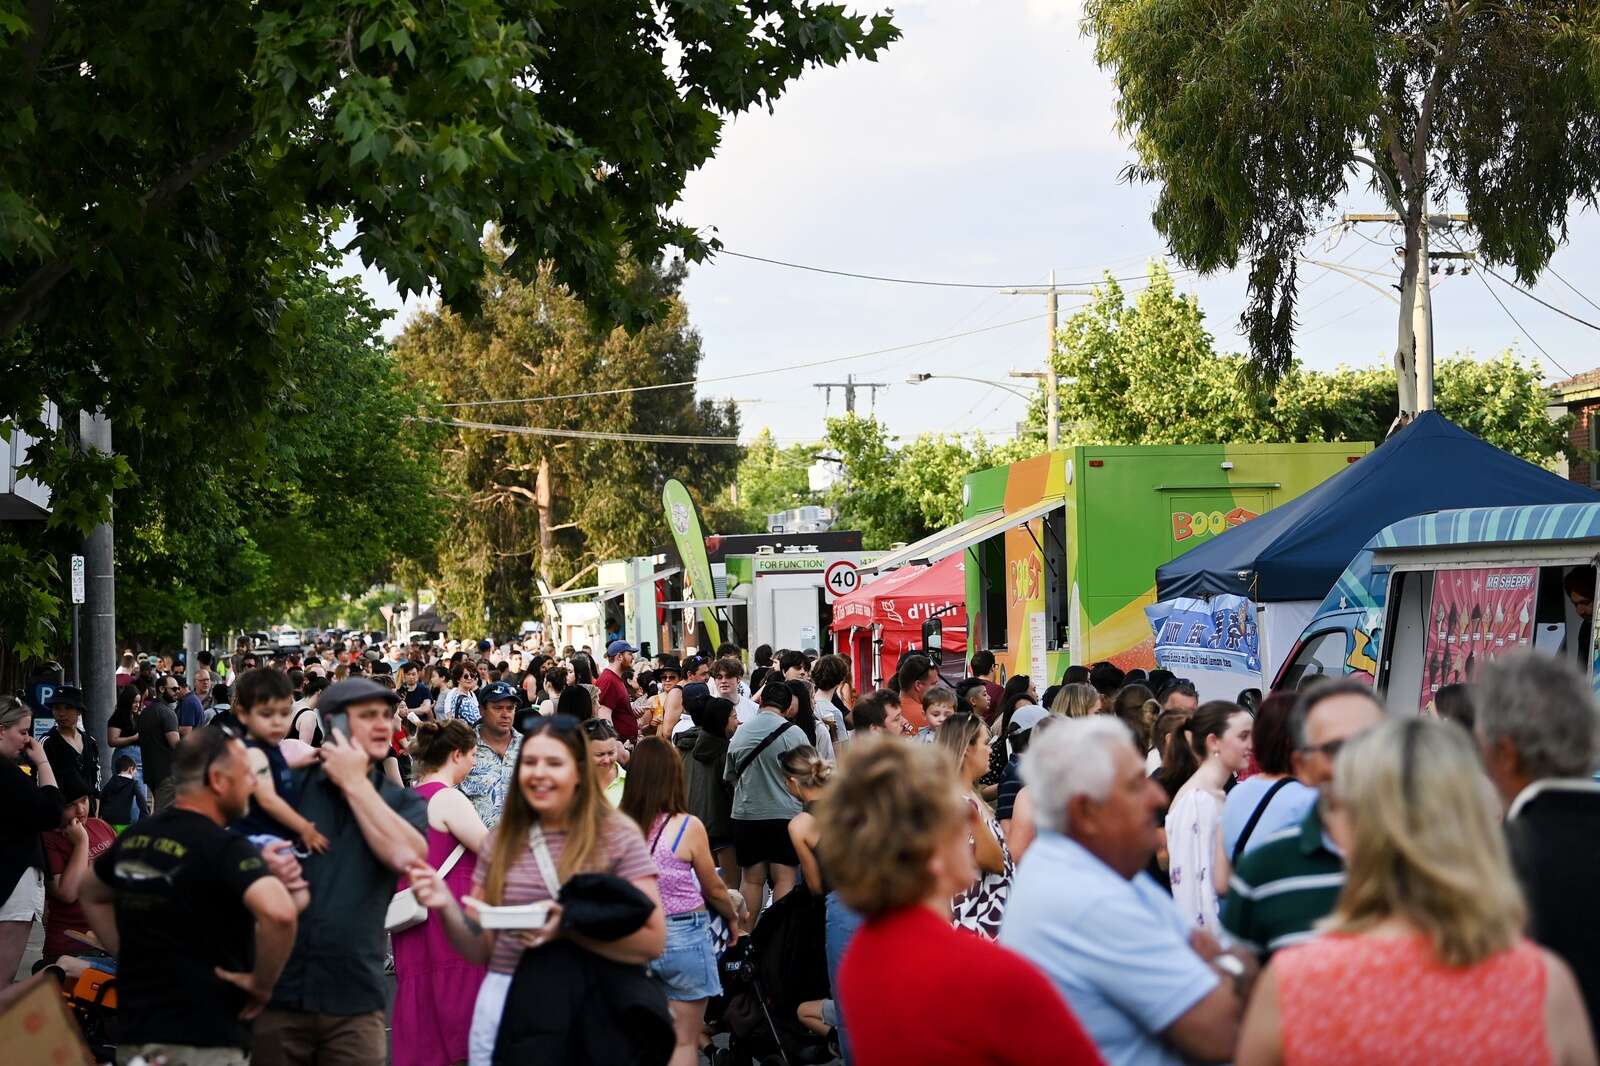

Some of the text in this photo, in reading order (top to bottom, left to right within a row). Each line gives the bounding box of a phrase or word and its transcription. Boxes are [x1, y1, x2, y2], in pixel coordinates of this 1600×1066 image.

[1172, 507, 1260, 541] BOO
[73, 560, 83, 571] 2P
[760, 560, 777, 569] FOR
[831, 571, 855, 588] 40
[908, 601, 957, 619] d'lish
[41, 686, 54, 705] P
